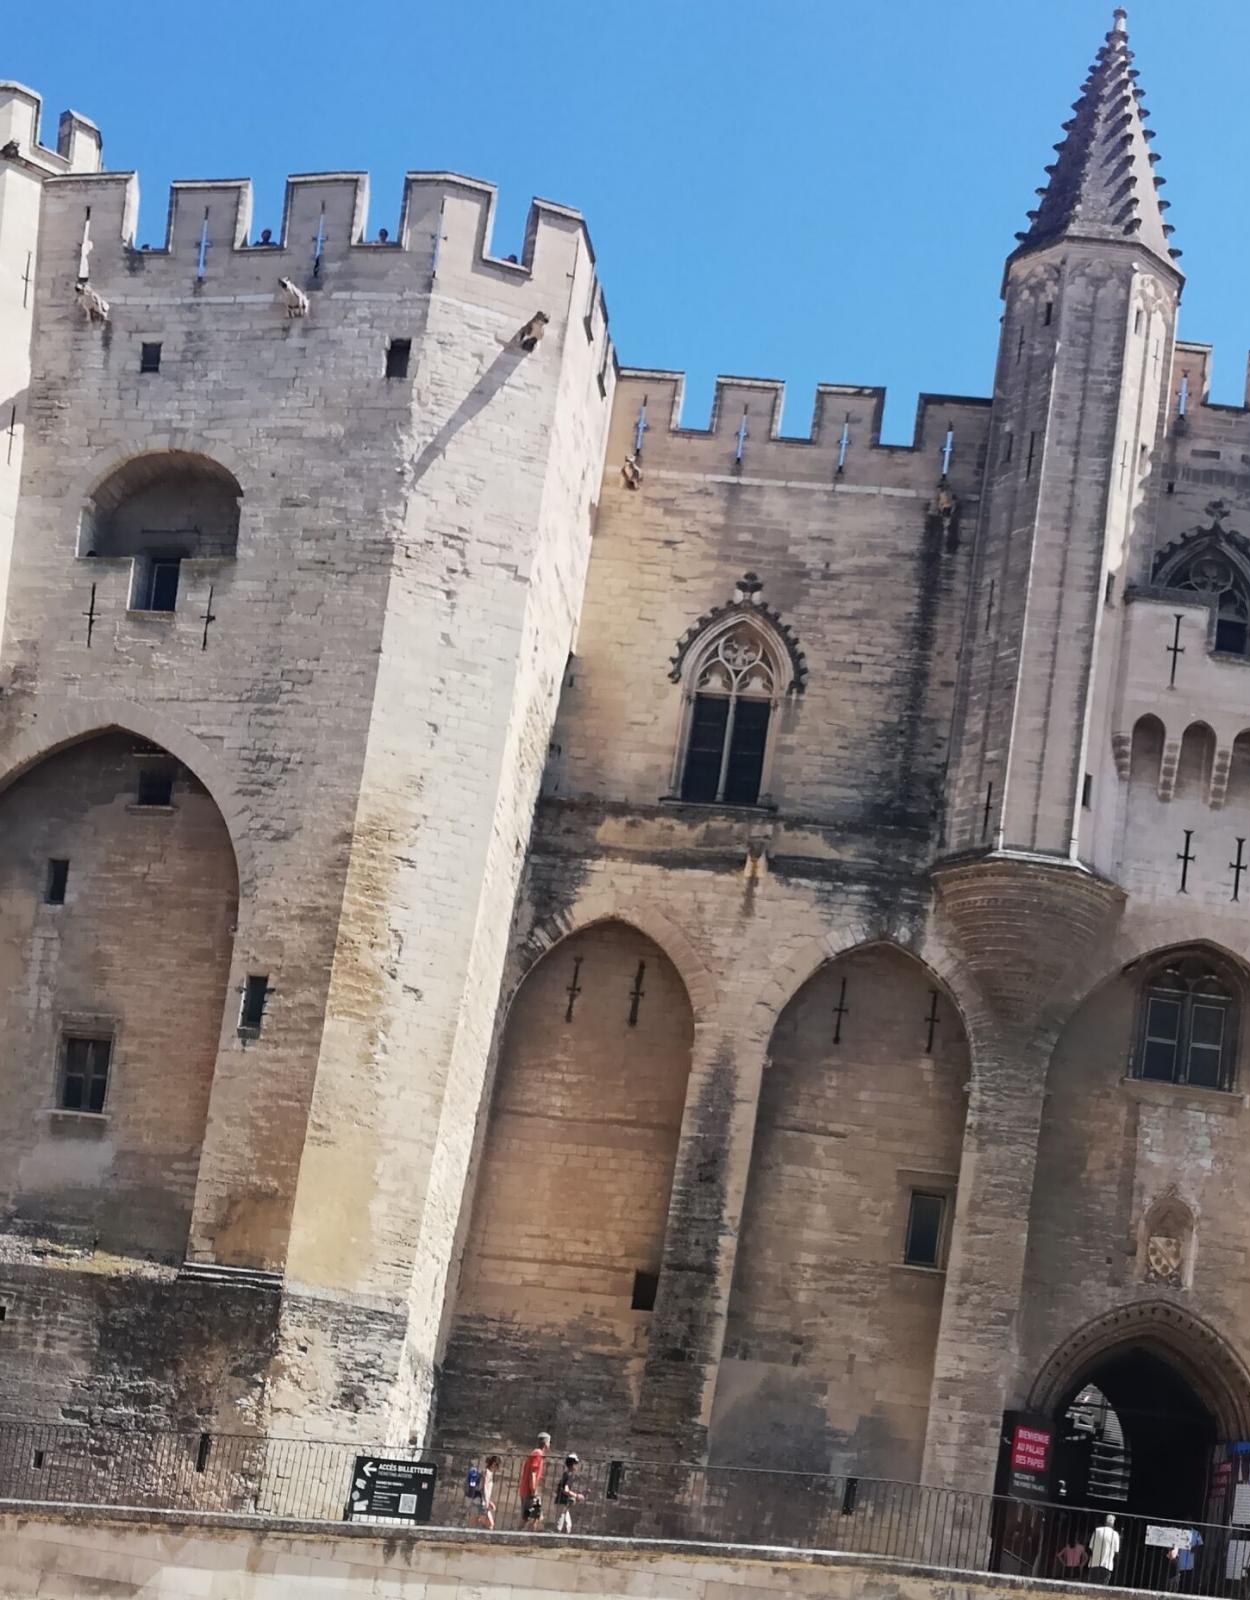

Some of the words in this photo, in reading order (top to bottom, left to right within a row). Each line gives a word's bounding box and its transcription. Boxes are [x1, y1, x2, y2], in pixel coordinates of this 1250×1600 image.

[1018, 1429, 1051, 1445] BIENVENUE
[1016, 1442, 1025, 1452] AU
[1025, 1443, 1045, 1456] PALAIS
[1015, 1454, 1026, 1465] DES
[1026, 1456, 1045, 1468] PAPES
[378, 1462, 397, 1472] ACCÈS
[397, 1465, 434, 1475] BILLETTERIE
